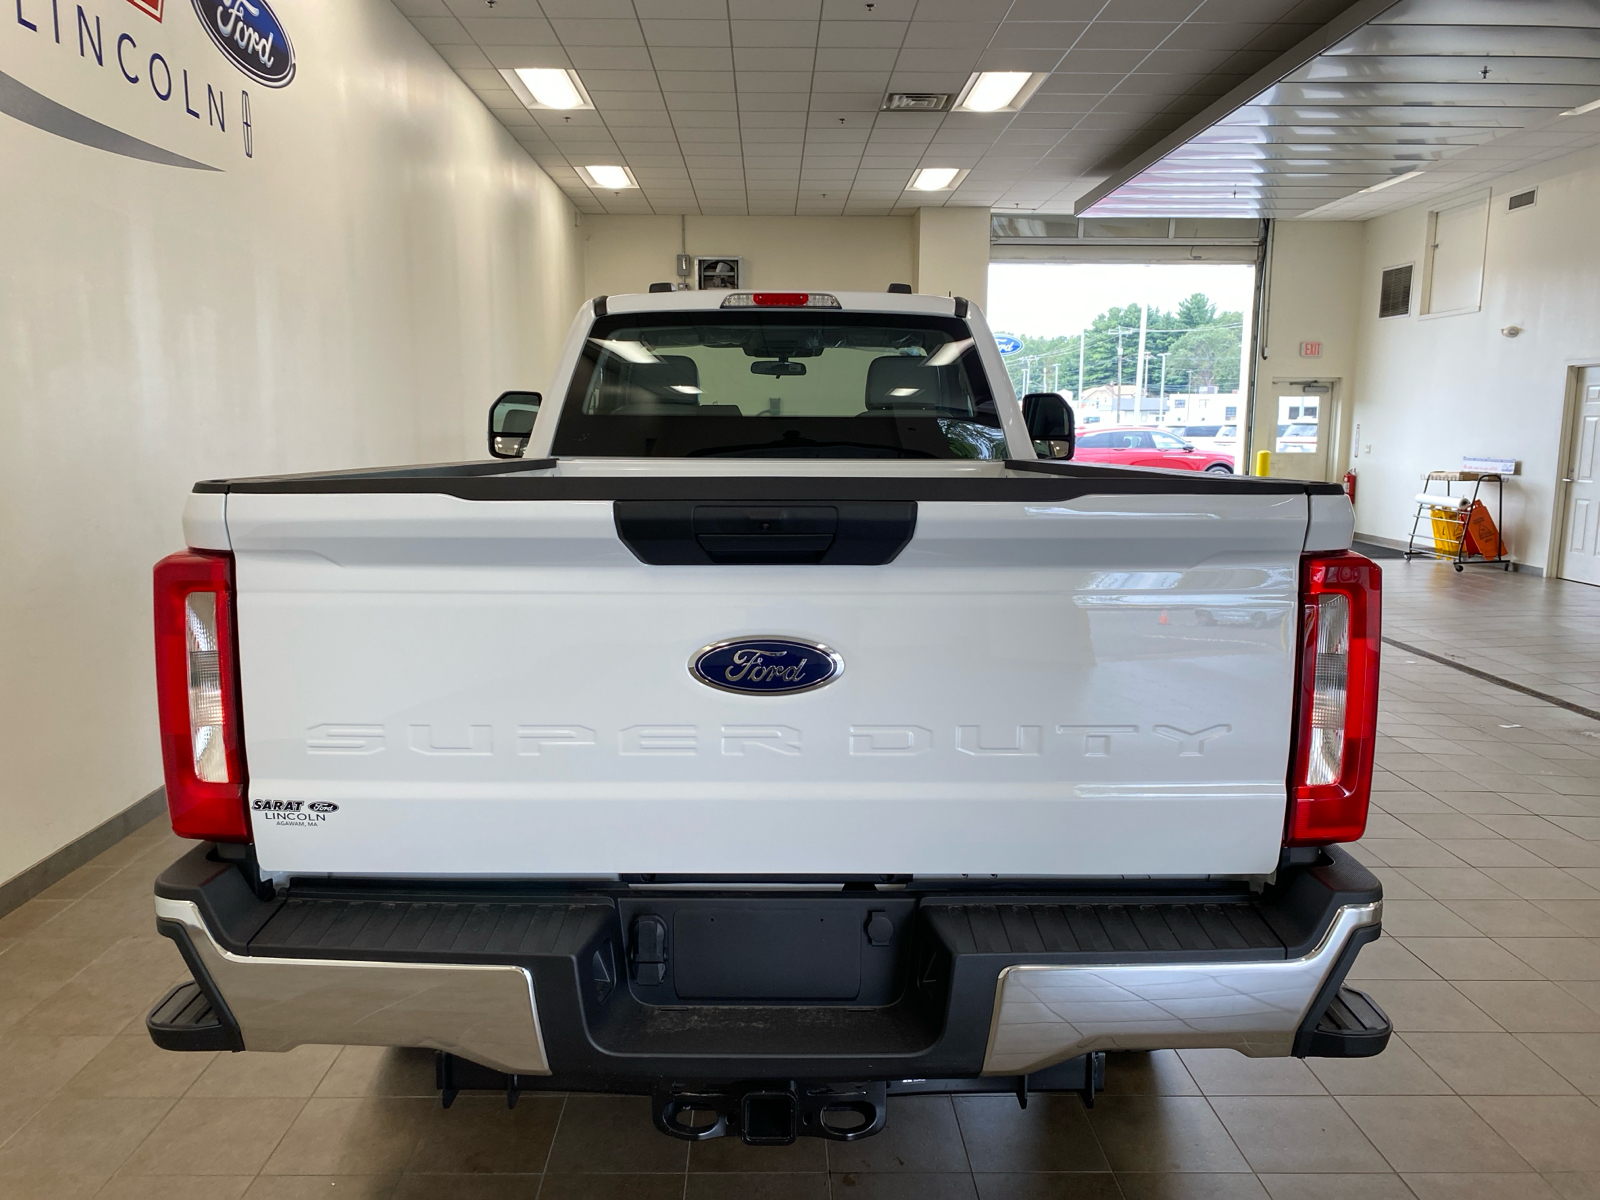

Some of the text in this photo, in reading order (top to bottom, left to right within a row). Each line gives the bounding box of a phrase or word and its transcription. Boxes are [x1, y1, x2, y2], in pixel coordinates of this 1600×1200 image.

[216, 0, 275, 68] Ford
[1304, 342, 1321, 356] EXIT
[724, 648, 808, 683] Ford
[306, 723, 1233, 757] SUPER DUTY
[252, 799, 304, 812] SARAT
[265, 813, 326, 821] LINCOLN
